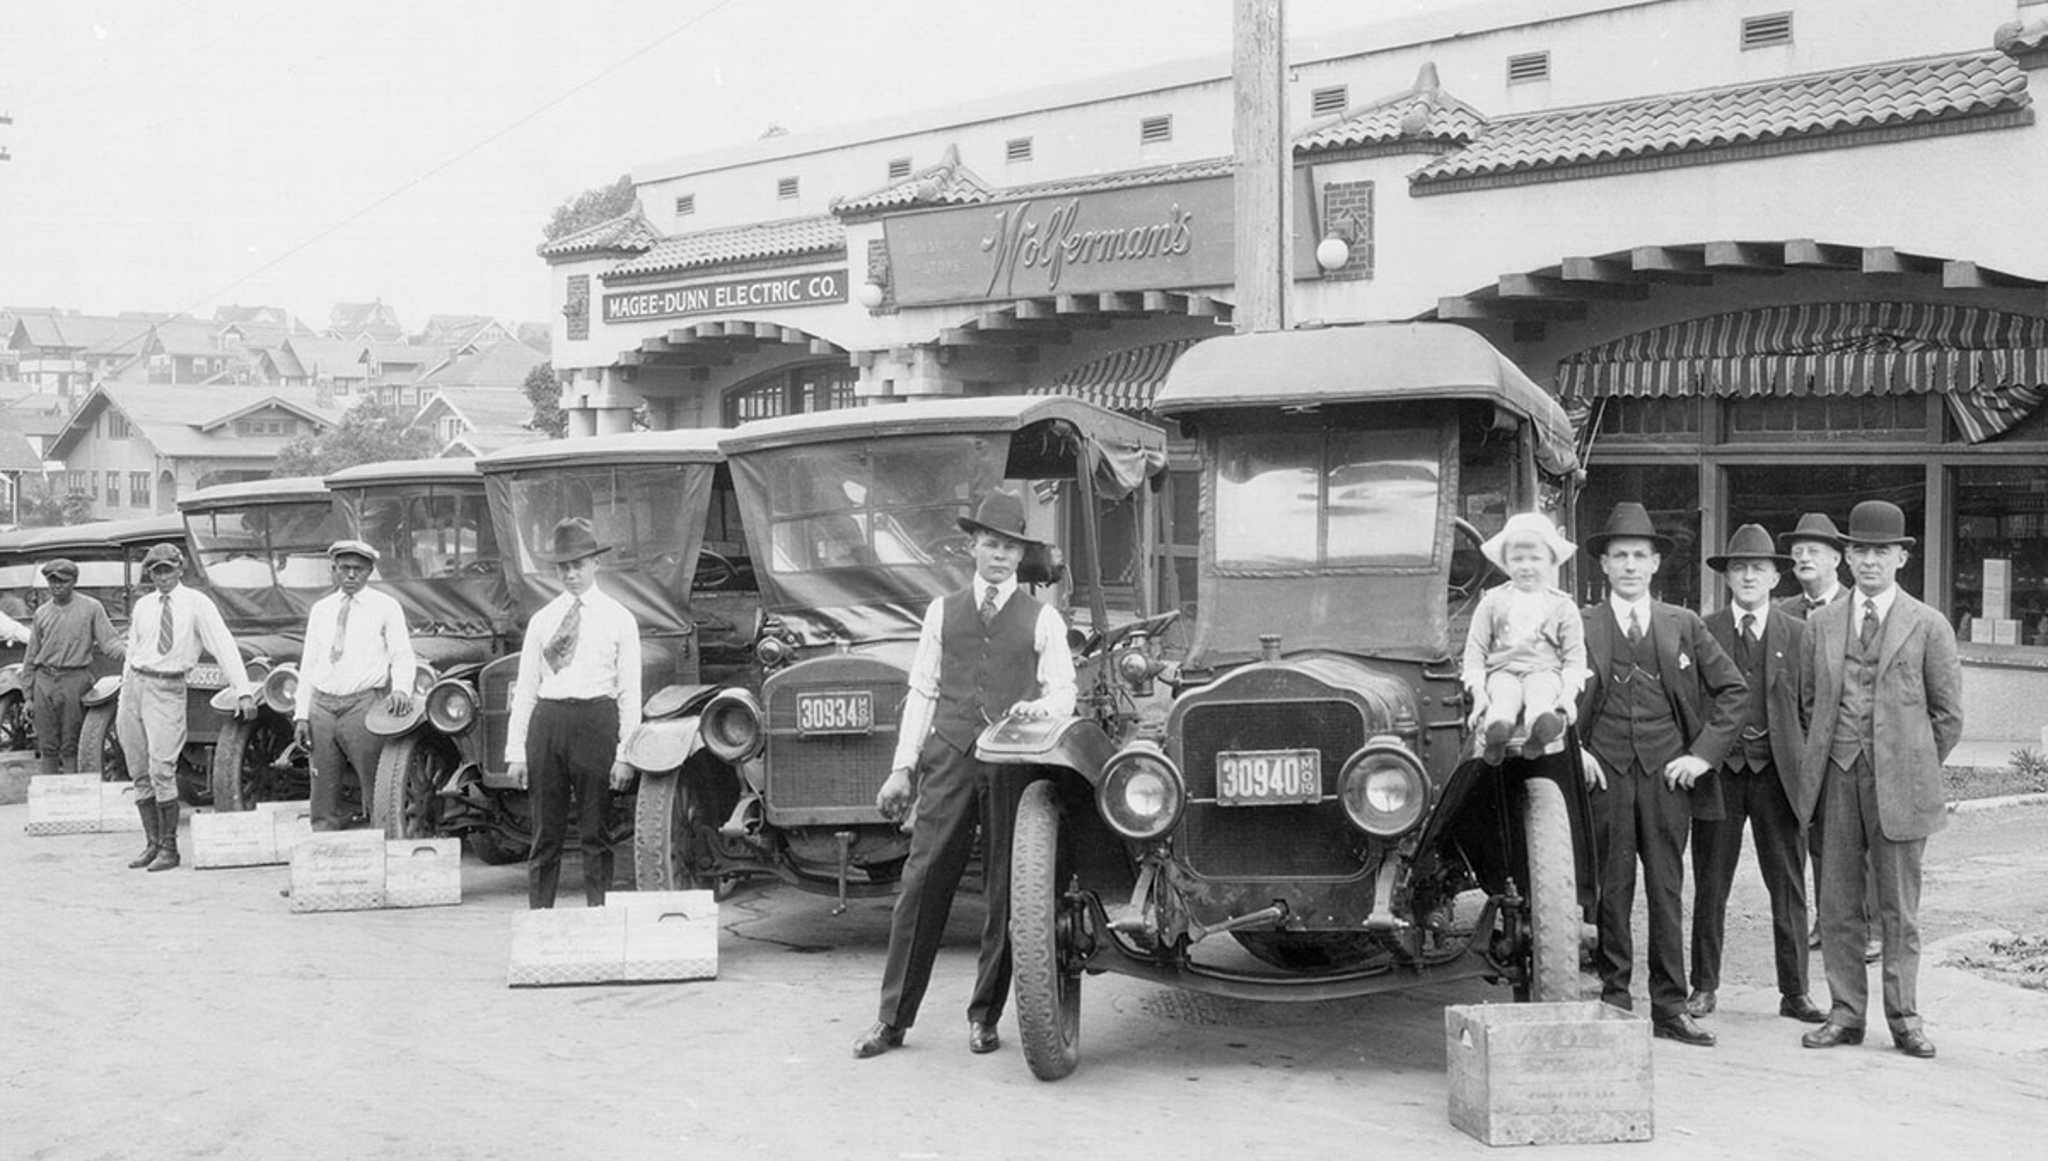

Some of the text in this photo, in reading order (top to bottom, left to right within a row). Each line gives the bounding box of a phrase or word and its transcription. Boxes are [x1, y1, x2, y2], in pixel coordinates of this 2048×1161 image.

[981, 197, 1193, 299] Wolferman's
[609, 275, 838, 318] MAGEE-DUNN ELECTRIC CO.
[801, 698, 857, 728] 30934
[1222, 758, 1299, 796] 30940
